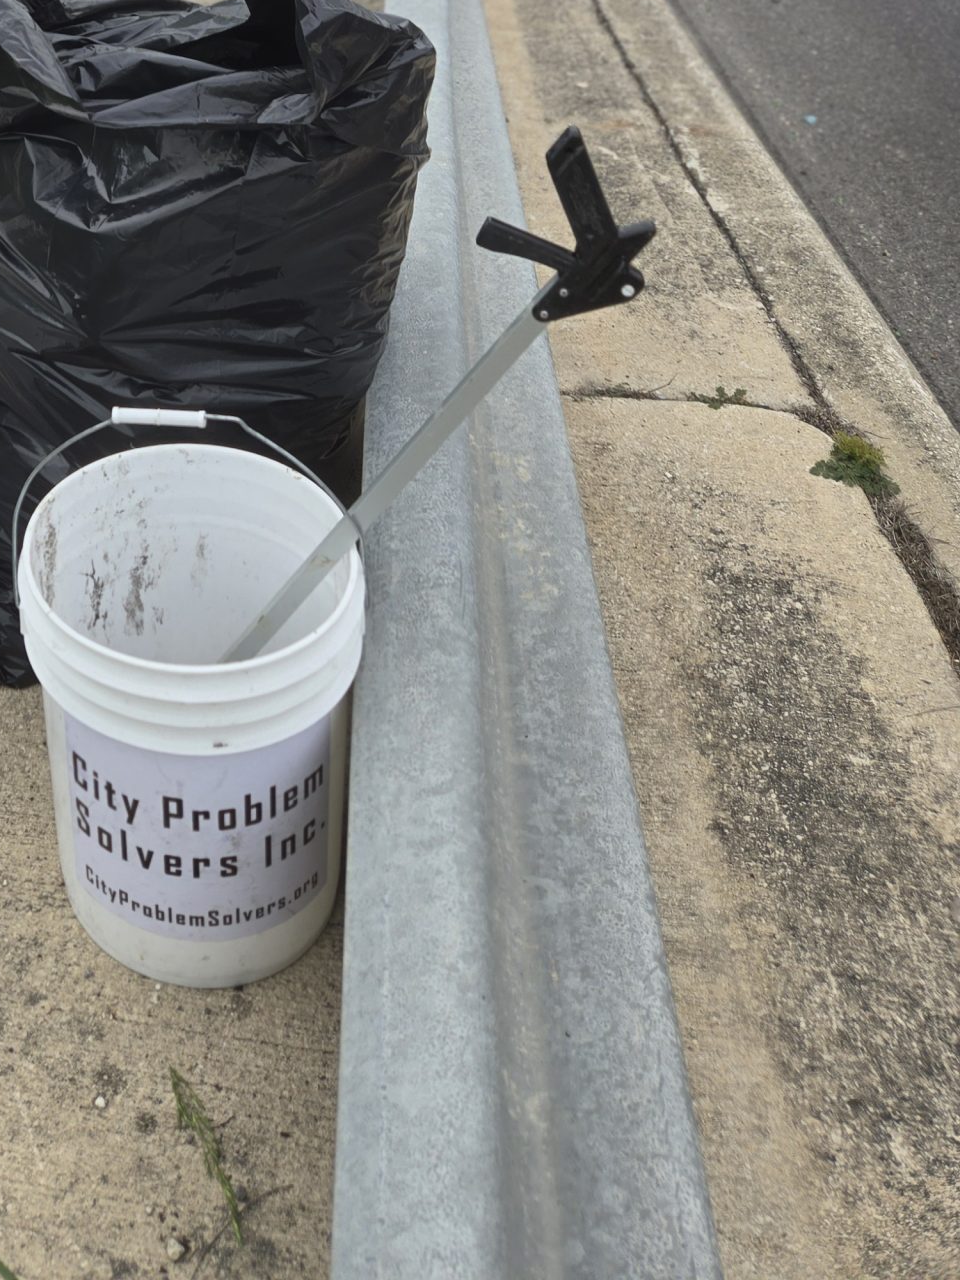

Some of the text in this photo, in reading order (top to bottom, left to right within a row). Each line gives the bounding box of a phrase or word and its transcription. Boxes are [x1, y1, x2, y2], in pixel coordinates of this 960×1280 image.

[72, 751, 324, 832] City Problem
[75, 797, 326, 879] Solvers Inc.
[85, 864, 318, 928] CityProblemSolvers.org
